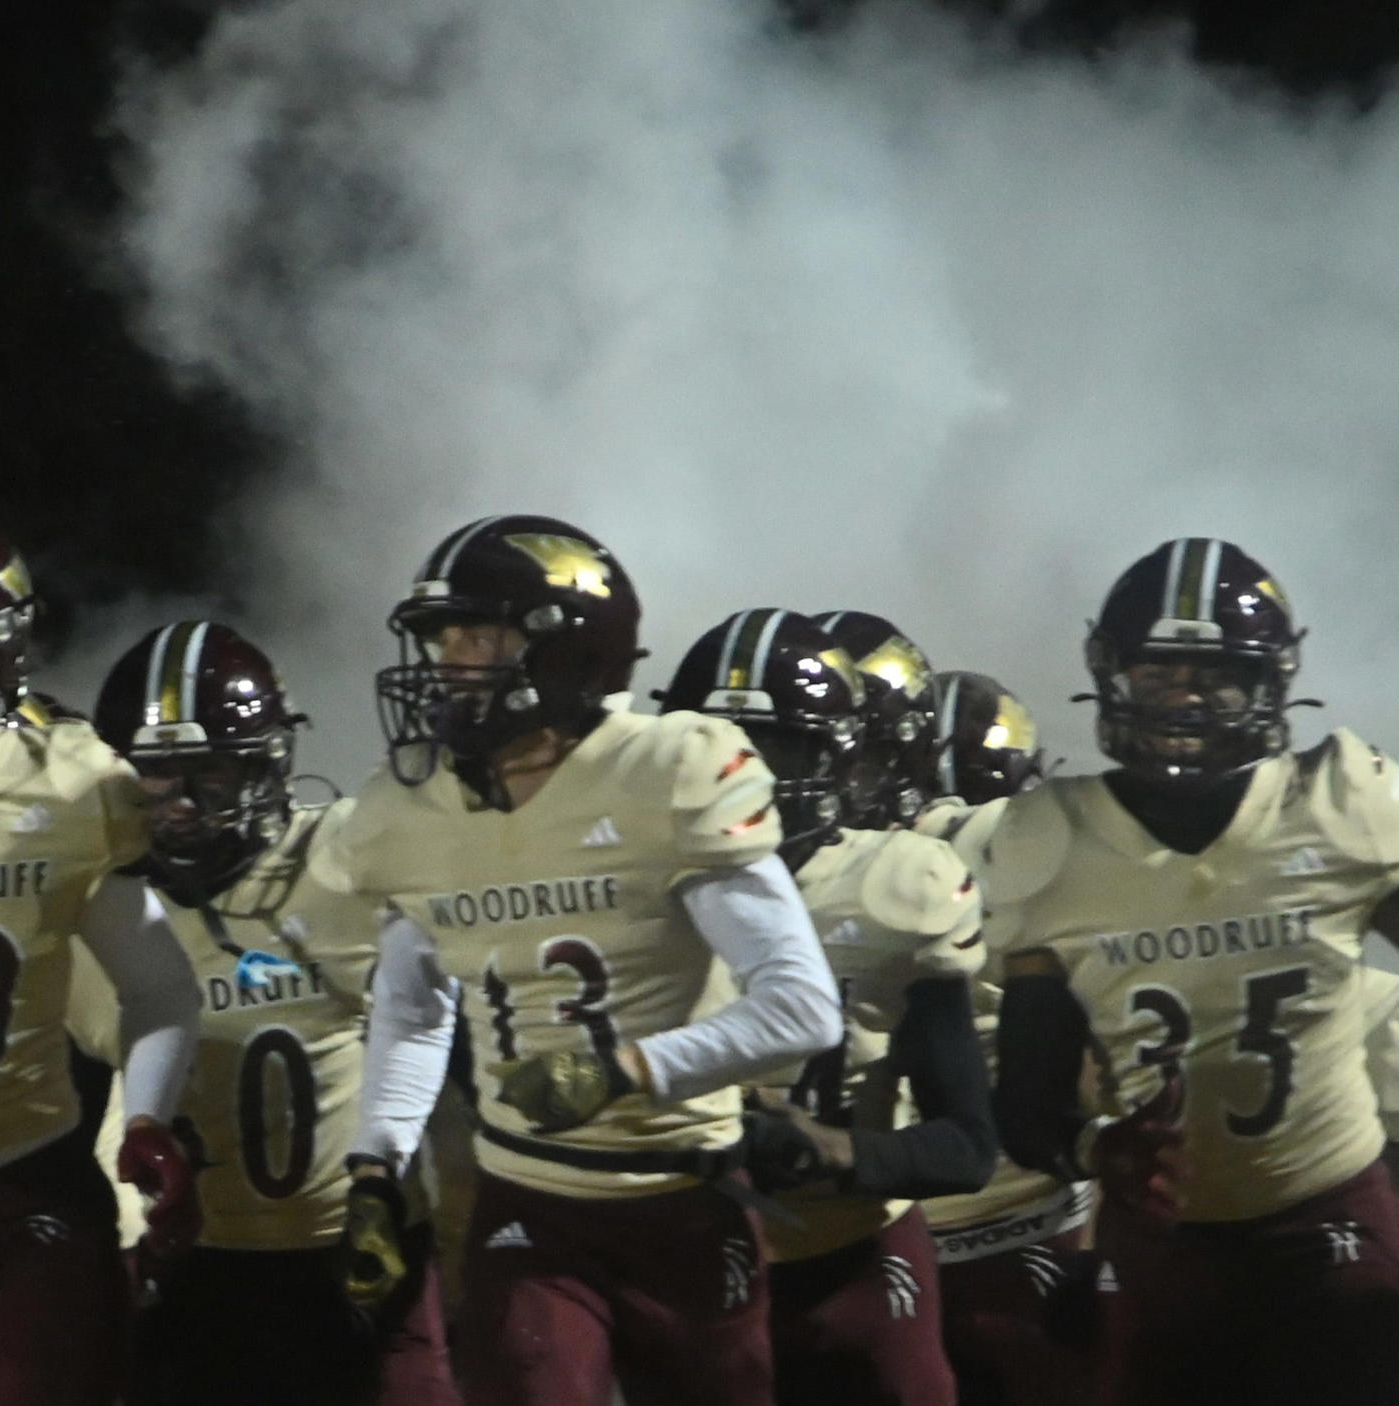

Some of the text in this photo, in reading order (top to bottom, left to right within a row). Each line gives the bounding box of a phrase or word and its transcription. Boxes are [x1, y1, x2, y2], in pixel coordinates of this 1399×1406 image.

[429, 876, 618, 926] WOODRUFF
[1102, 908, 1311, 964] WOODRUFF
[483, 936, 617, 1060] 13
[1128, 965, 1311, 1138] 35
